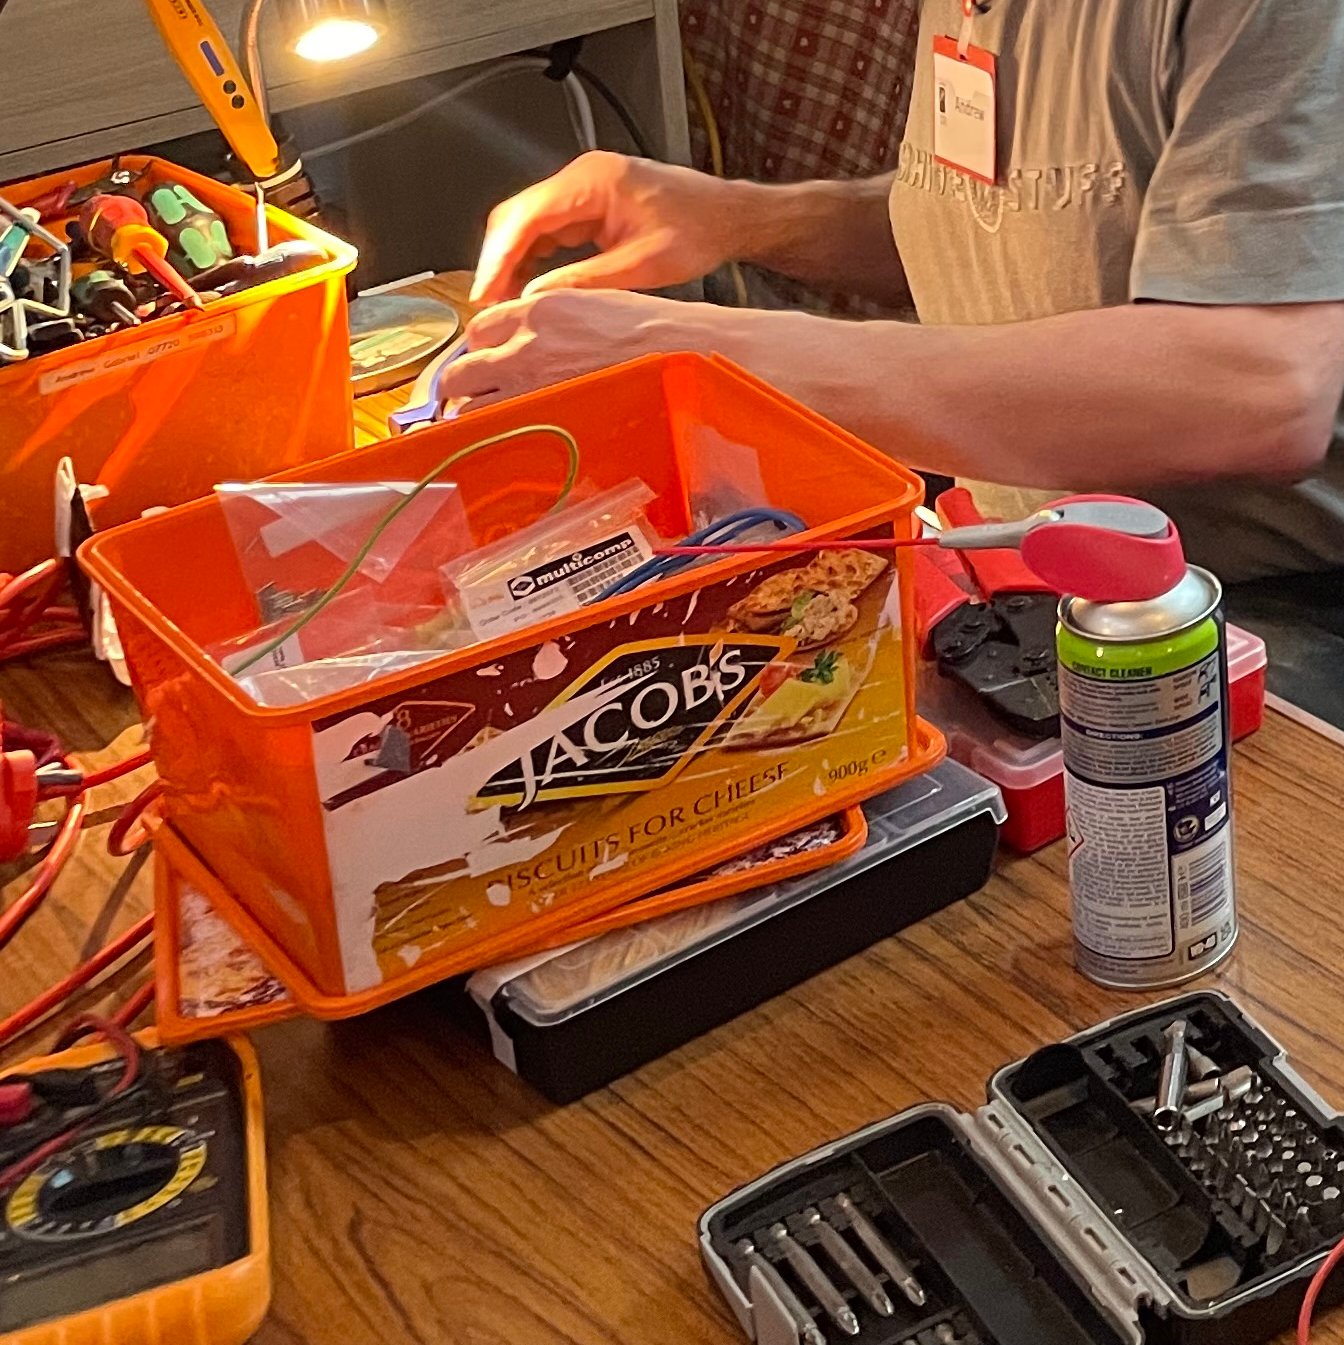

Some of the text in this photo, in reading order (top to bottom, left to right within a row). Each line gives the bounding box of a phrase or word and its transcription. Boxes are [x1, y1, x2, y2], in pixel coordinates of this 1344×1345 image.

[535, 537, 633, 586] multicomp
[1109, 665, 1153, 679] CLEANER
[828, 758, 869, 785] 900g
[486, 832, 620, 895] ISCUITS
[629, 806, 686, 844] FOR
